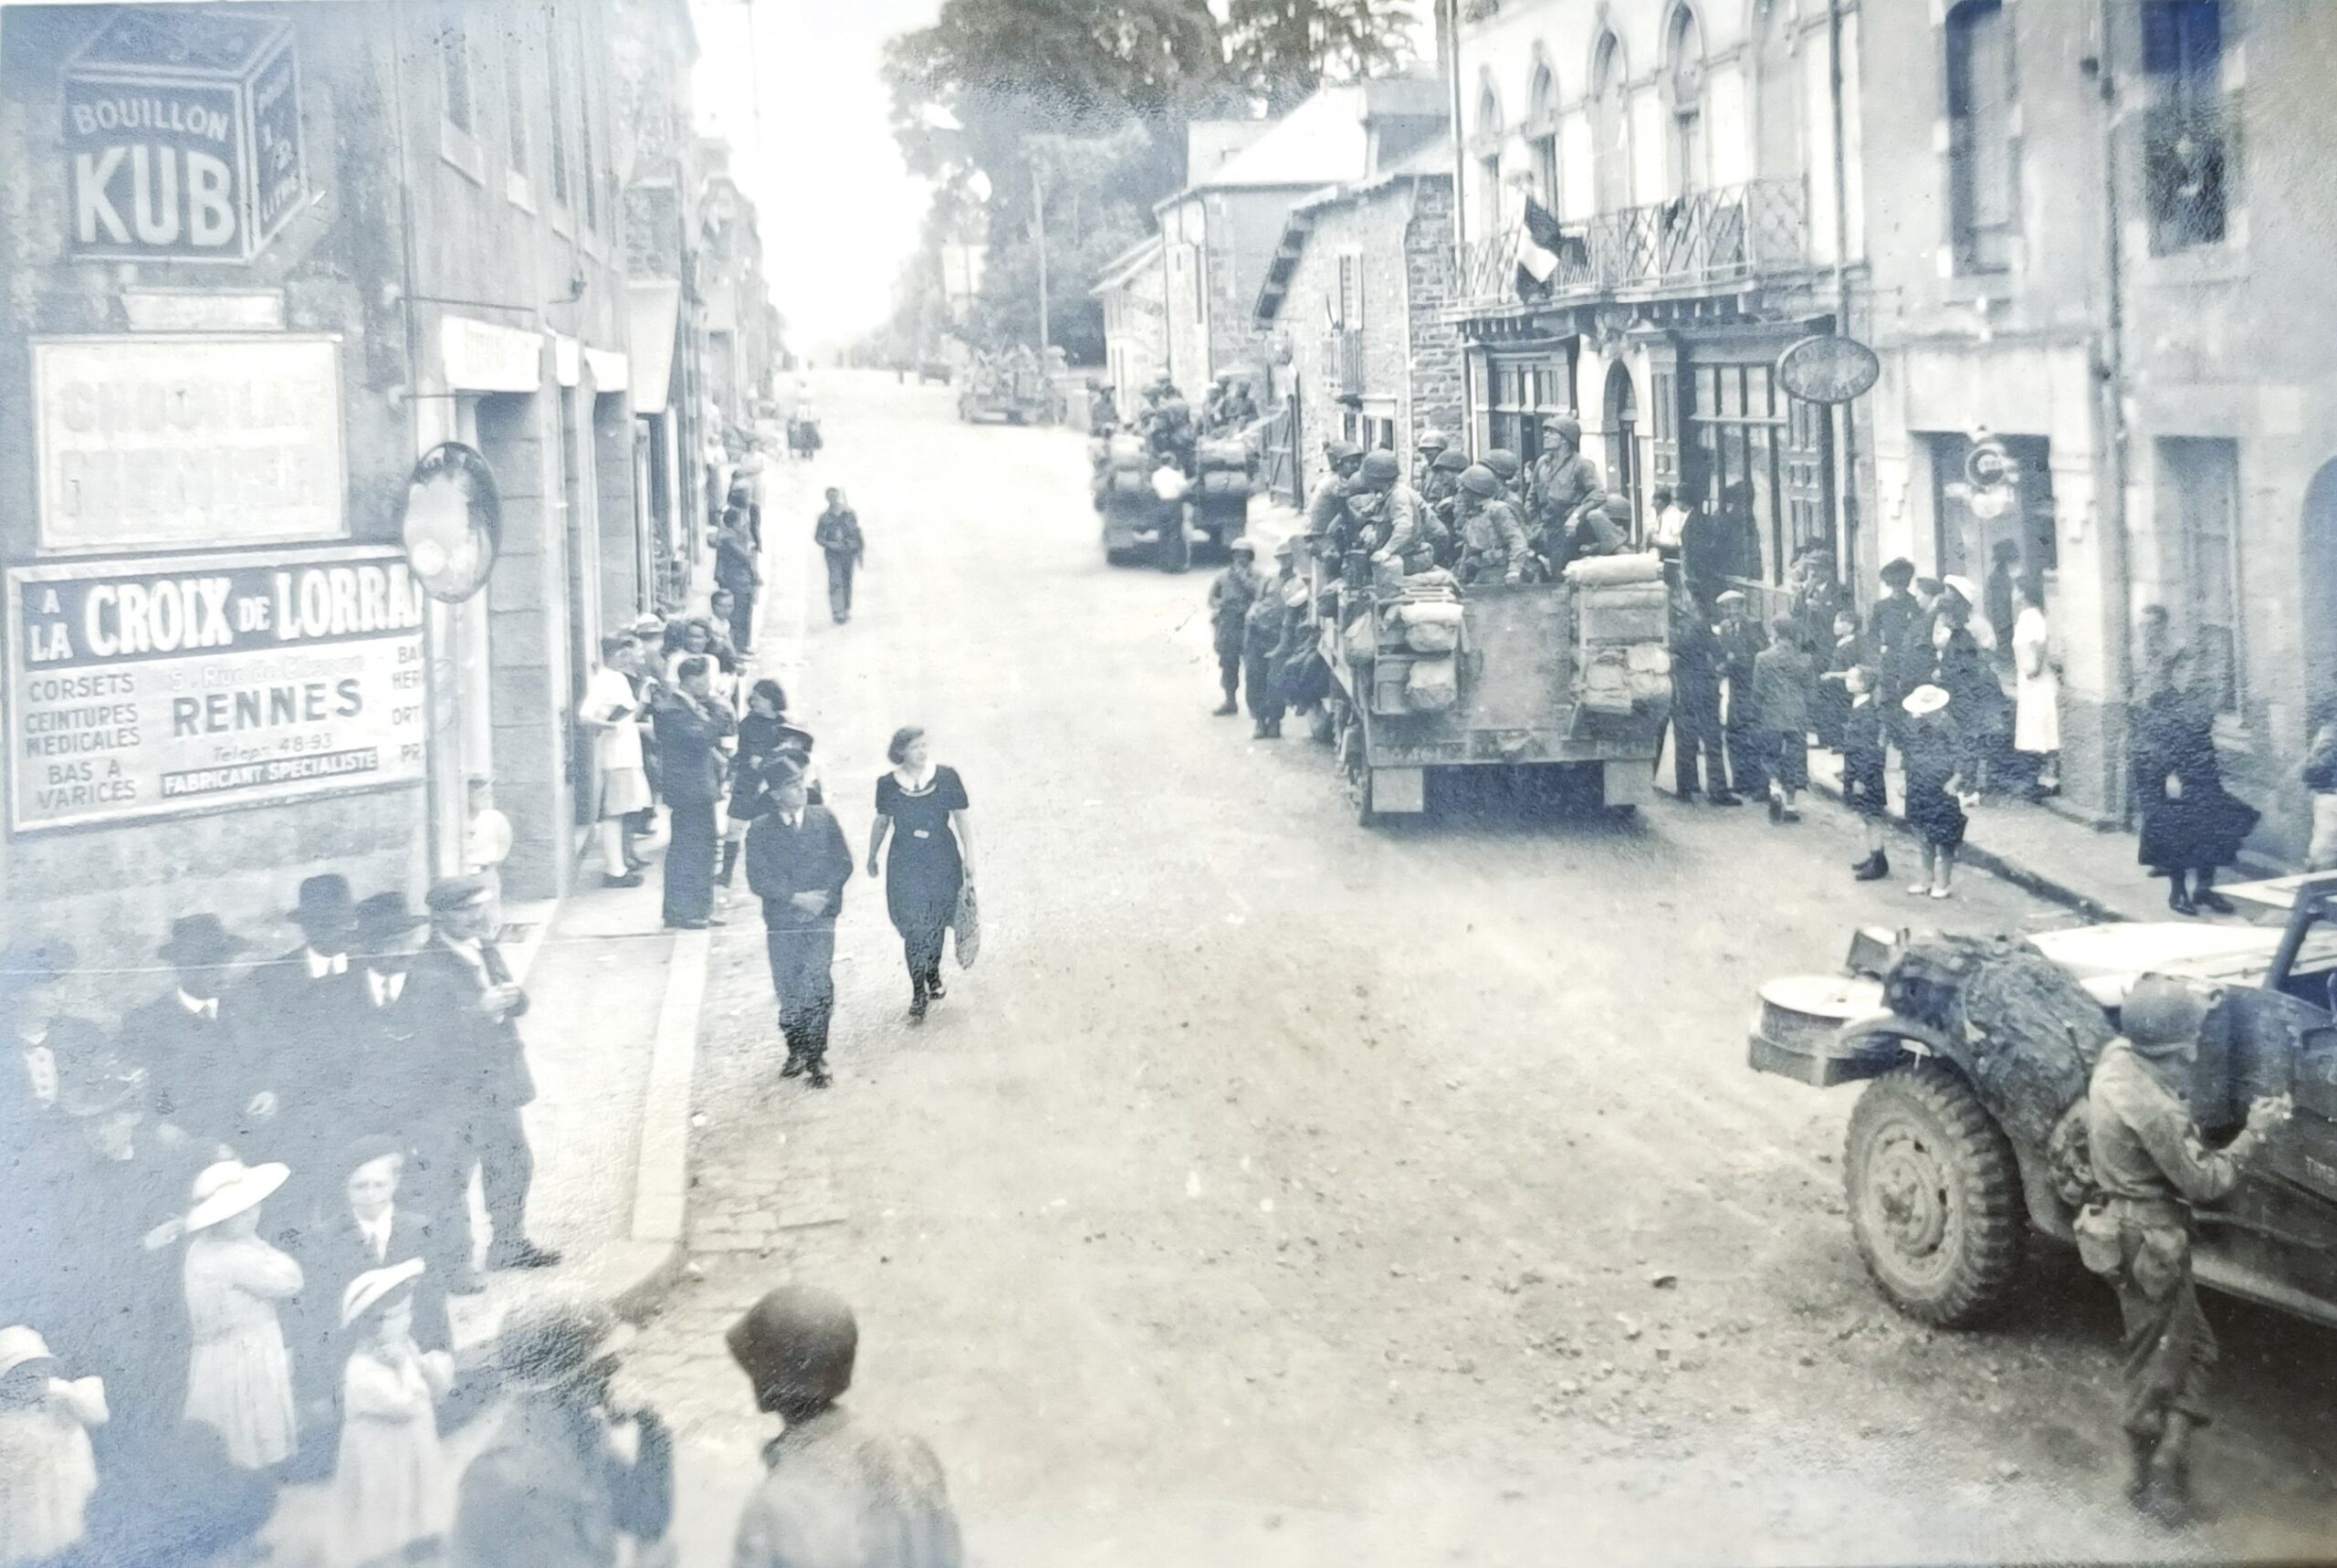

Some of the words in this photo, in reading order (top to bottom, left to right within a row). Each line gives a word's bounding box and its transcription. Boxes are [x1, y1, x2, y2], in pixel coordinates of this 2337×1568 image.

[73, 99, 227, 141] BOUILLON
[77, 143, 236, 246] KUB
[42, 588, 61, 613] A
[29, 622, 74, 662] LA
[83, 577, 234, 657] CROIX
[238, 596, 271, 632] DE
[396, 645, 423, 664] BA
[28, 673, 134, 703] CORSETS
[25, 703, 138, 734] CEINTURES
[173, 678, 363, 737] RENNES
[392, 706, 423, 726] ORT
[26, 727, 141, 758] MEDICALES
[400, 743, 424, 763] PR
[47, 761, 93, 786] BAS
[107, 758, 121, 779] A
[164, 765, 263, 796] FABRICANT
[267, 752, 378, 781] SPECIALISTE
[37, 779, 137, 810] VARICES
